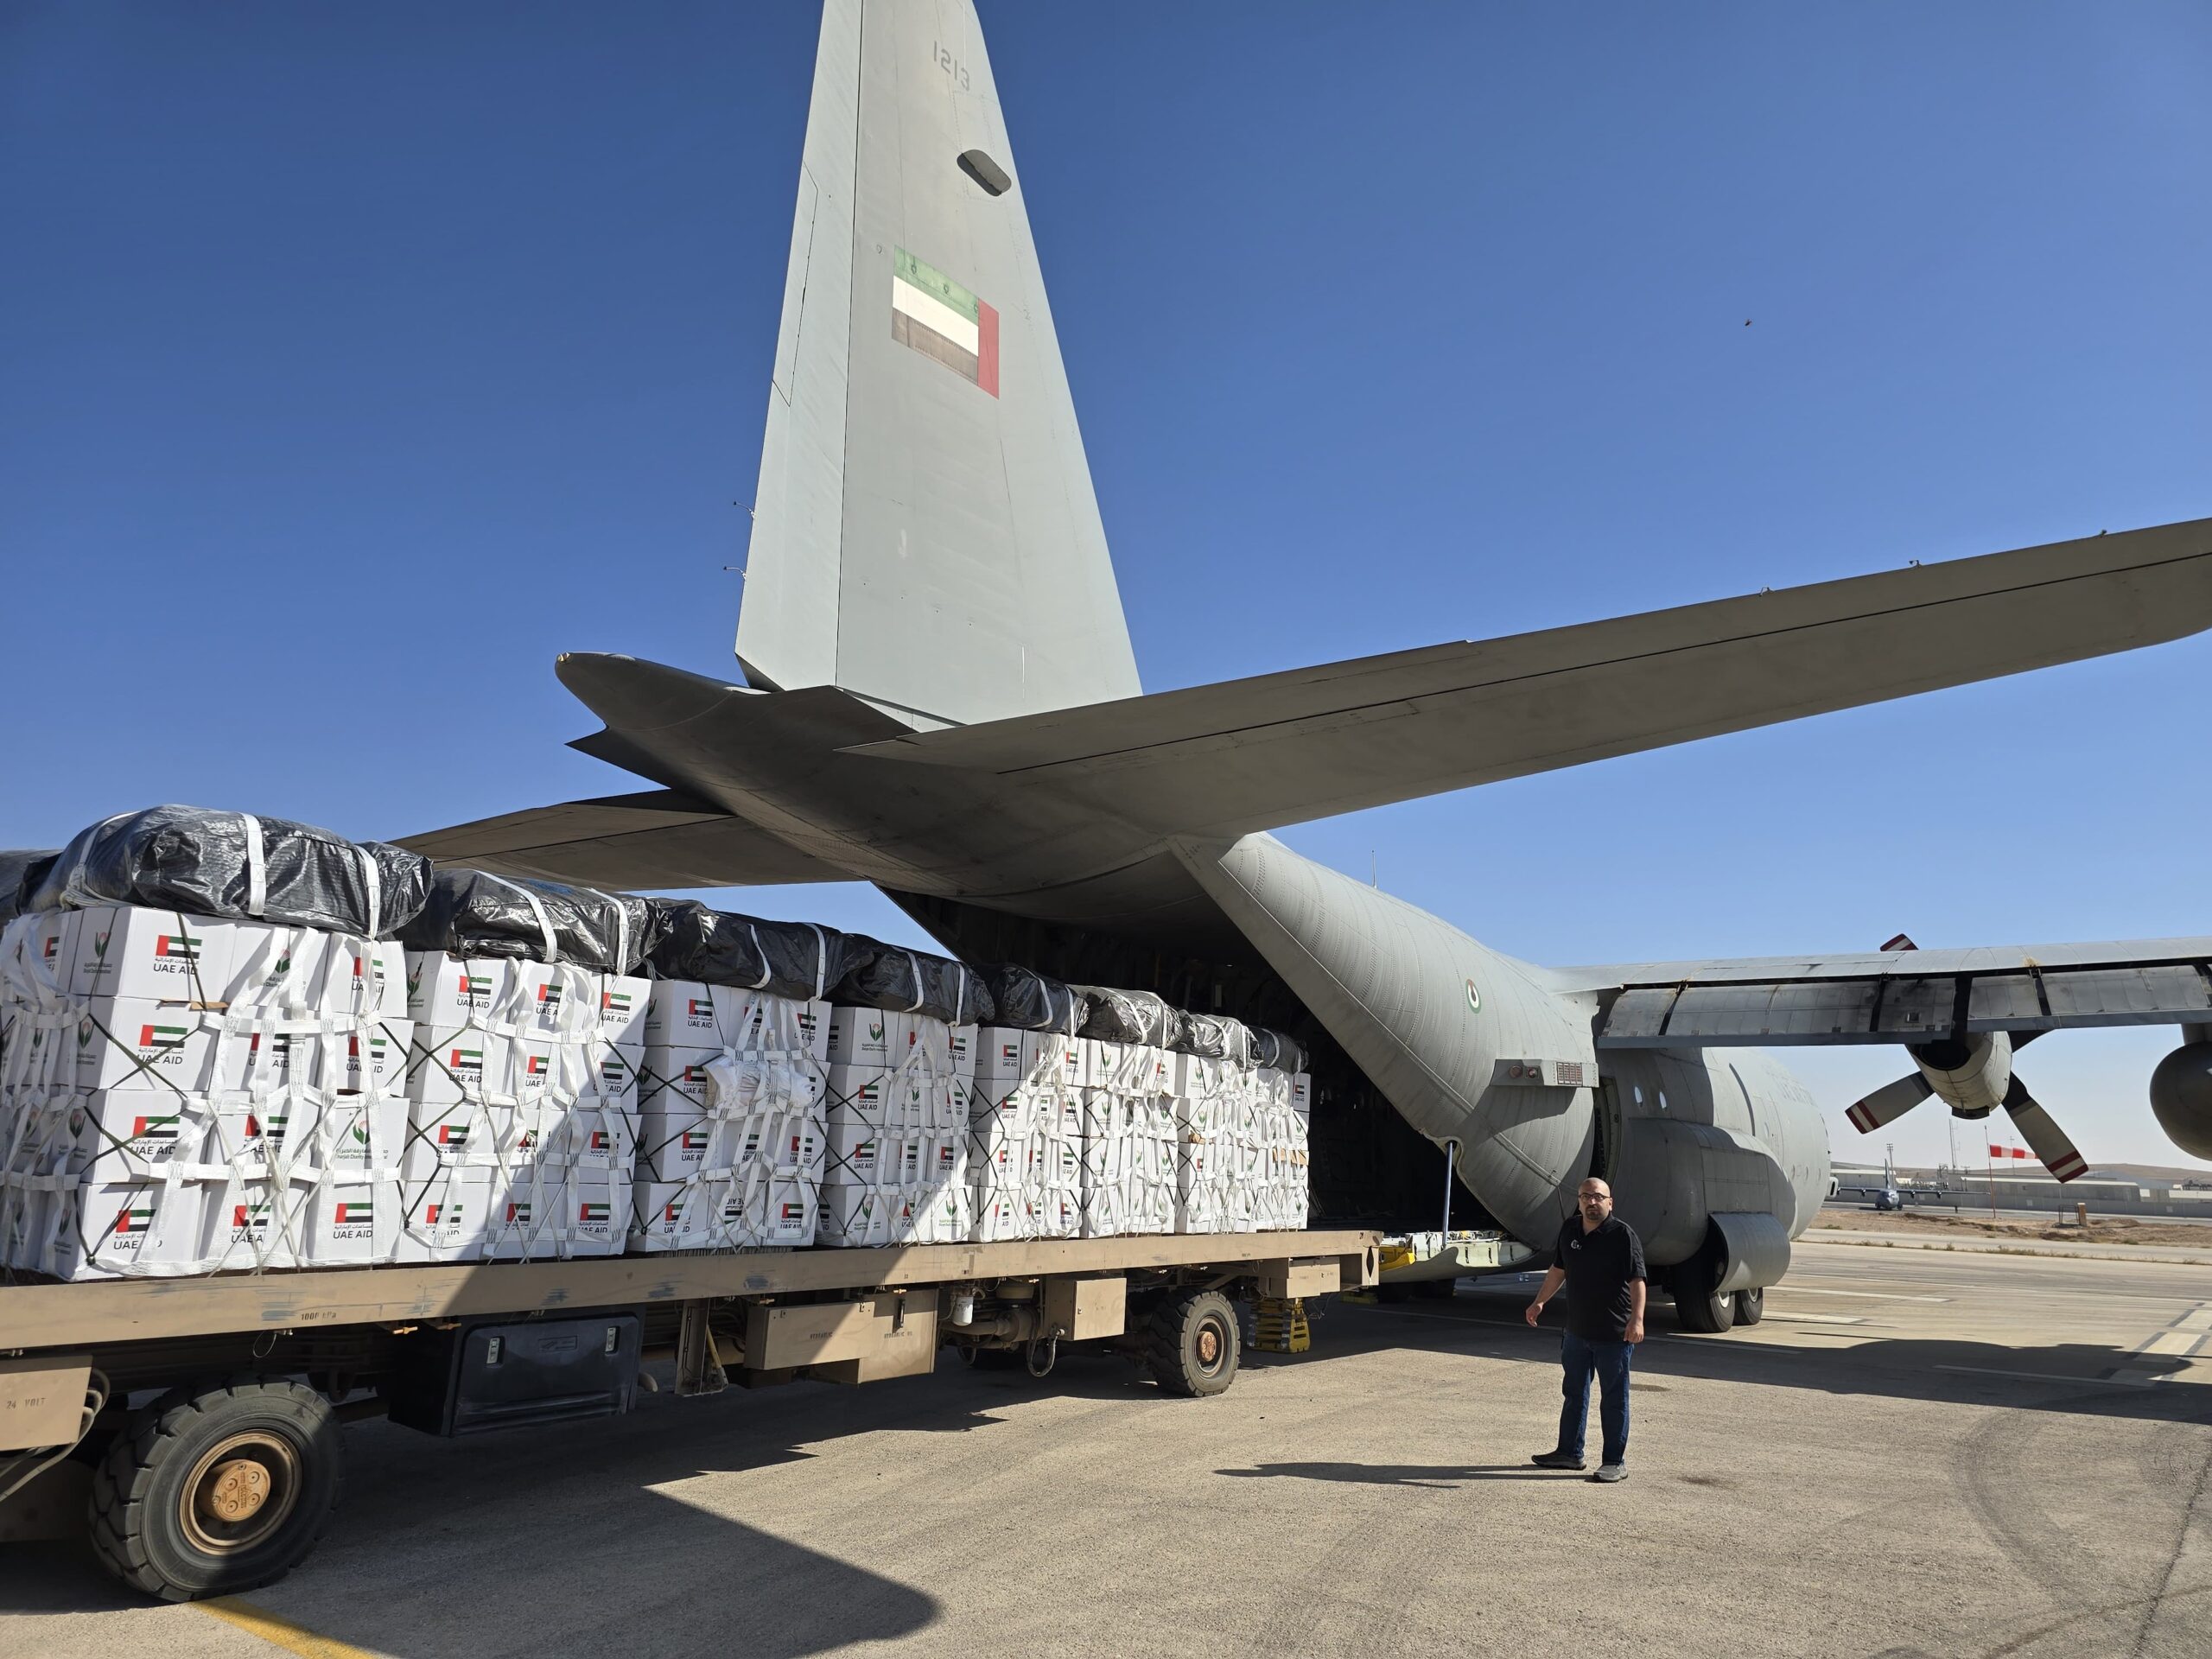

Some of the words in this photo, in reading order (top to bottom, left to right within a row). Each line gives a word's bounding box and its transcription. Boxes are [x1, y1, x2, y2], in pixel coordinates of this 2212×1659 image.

[933, 41, 970, 92] 1213
[153, 963, 176, 974] UAE
[456, 998, 473, 1007] UAE
[474, 1001, 490, 1009] AID
[536, 1007, 551, 1015] UAE
[162, 1055, 183, 1065] AID
[346, 1063, 362, 1072] UA
[467, 1075, 482, 1084] AID
[525, 1078, 541, 1088] UAE
[333, 1230, 353, 1240] UAE
[355, 1230, 373, 1239] AID
[113, 1240, 139, 1250] UAE
[6, 1400, 16, 1409] 24
